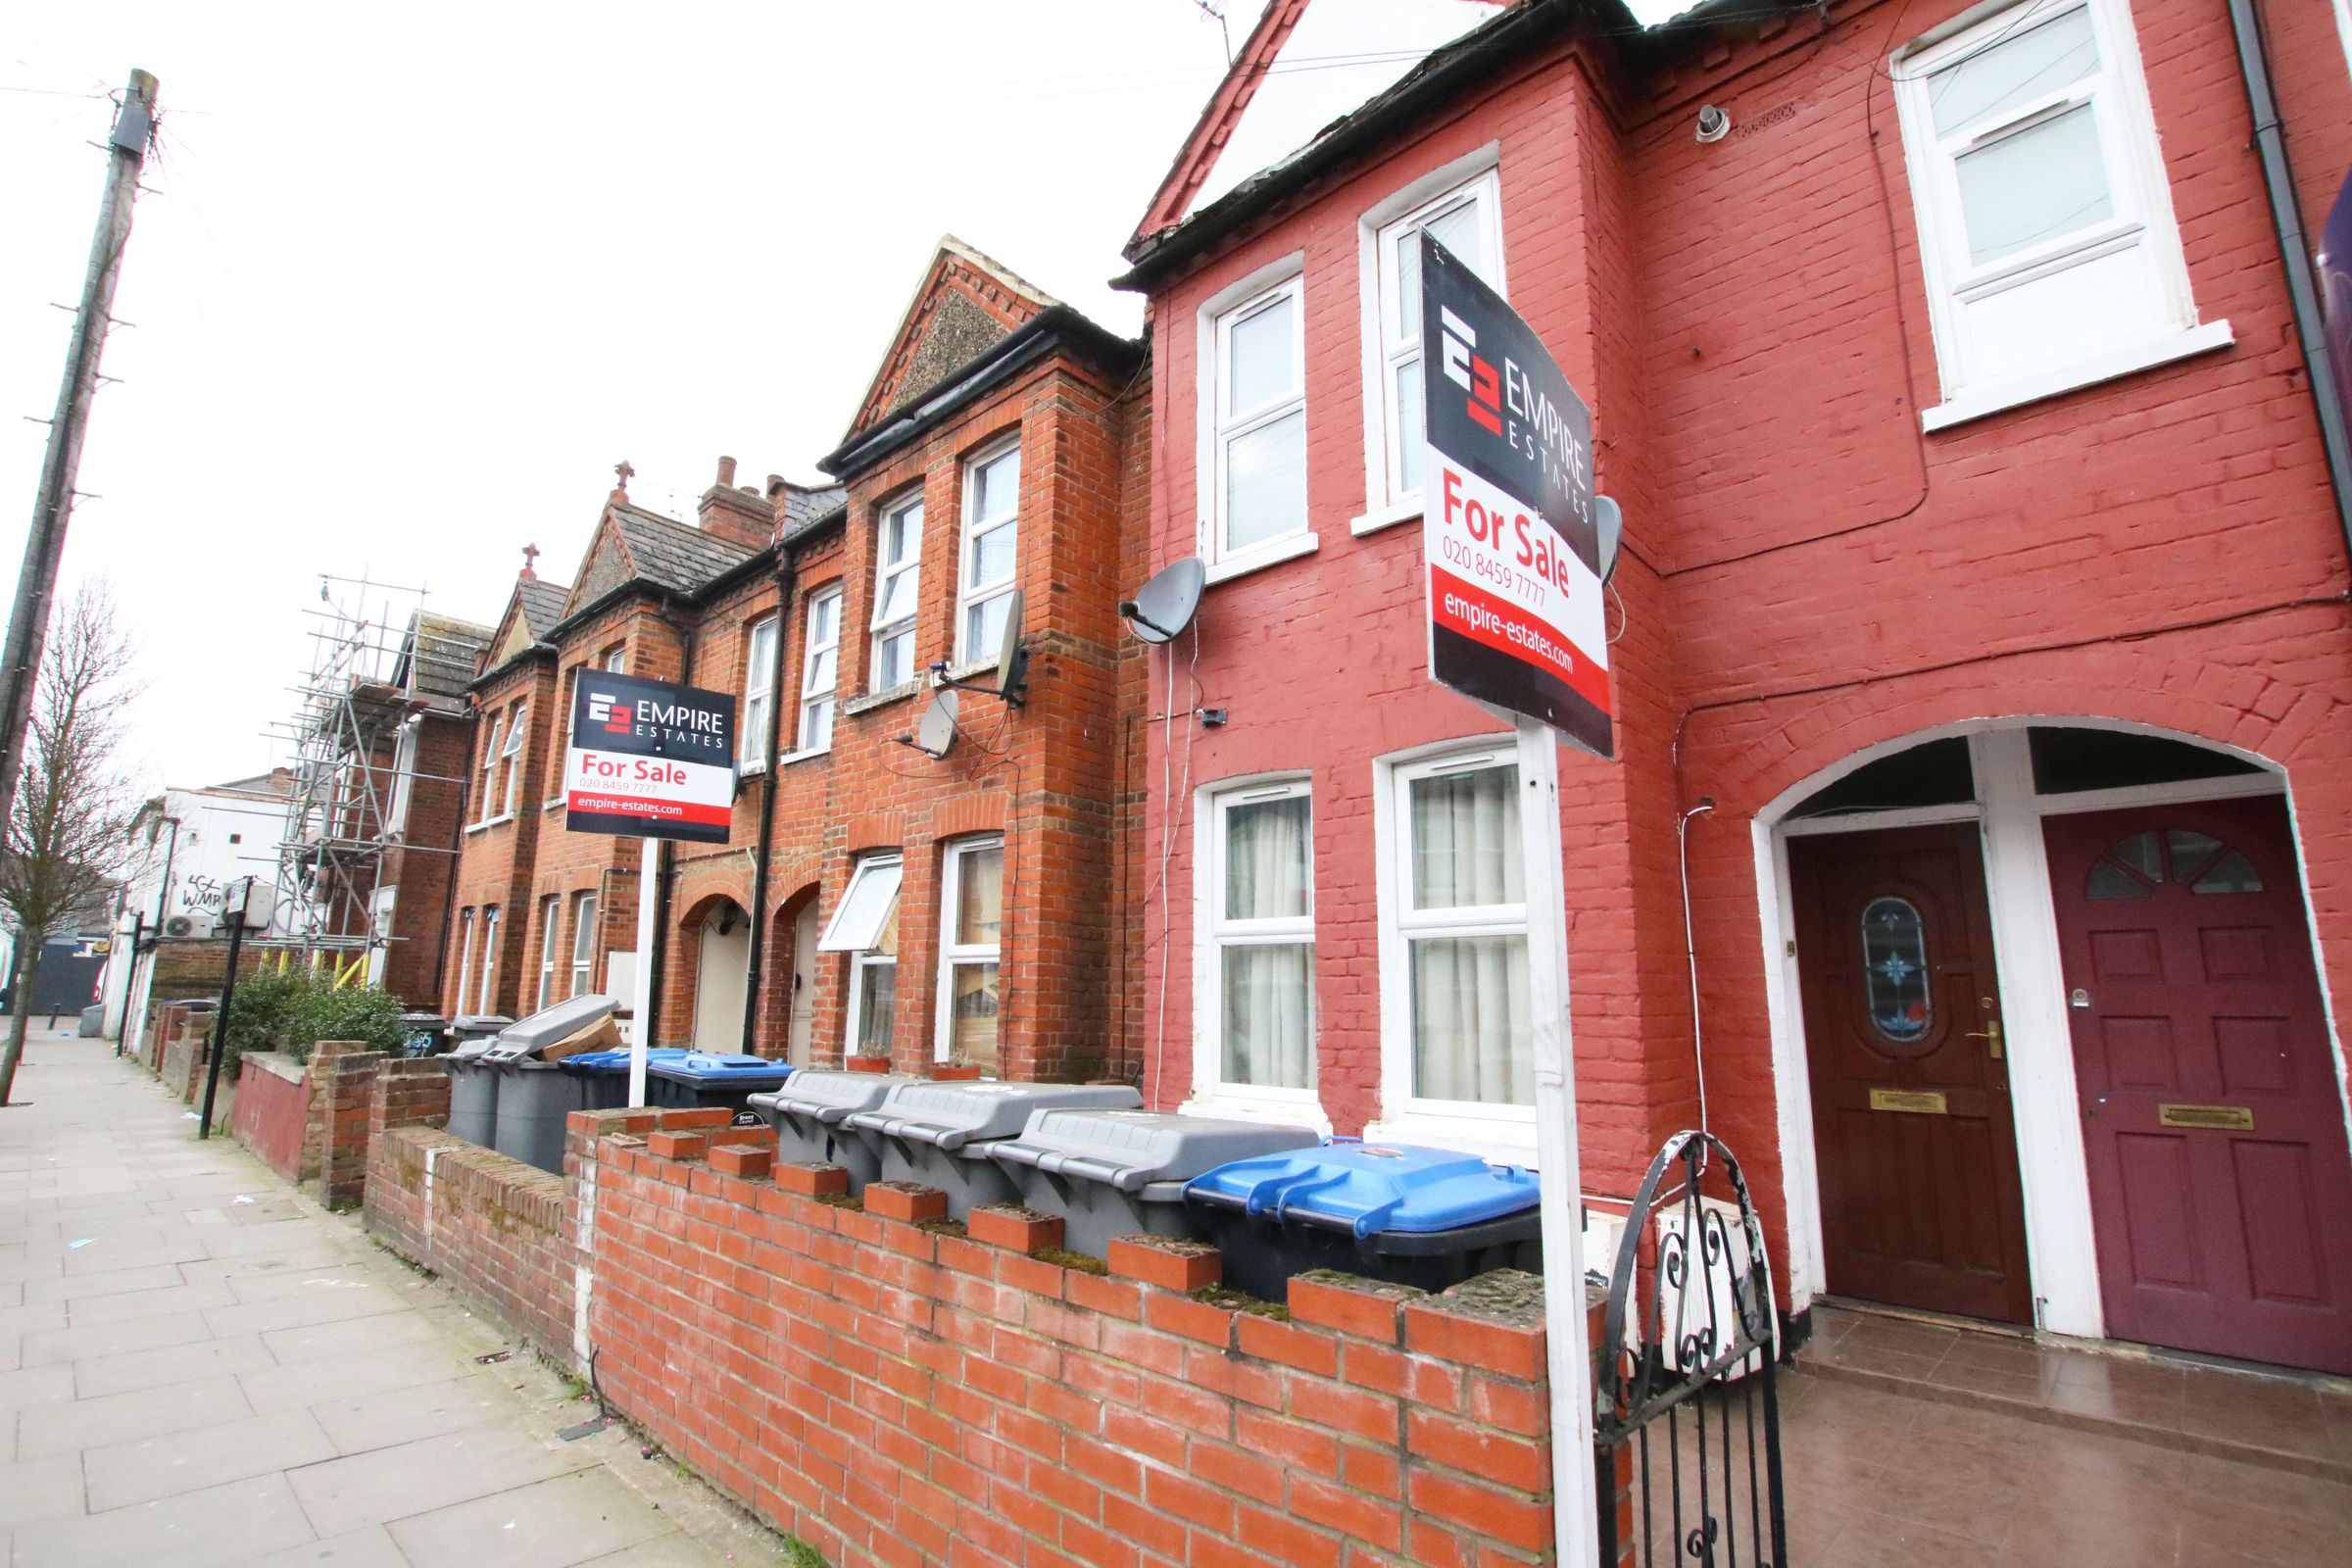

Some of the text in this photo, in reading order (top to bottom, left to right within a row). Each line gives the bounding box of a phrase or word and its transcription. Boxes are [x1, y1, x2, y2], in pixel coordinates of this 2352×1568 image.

[1504, 356, 1586, 491] EMPIRE
[1508, 419, 1589, 524] ESTATES
[1443, 466, 1569, 599] For Sale
[1443, 535, 1545, 608] 020 8459 7777
[1445, 592, 1574, 675] empire-estates.com
[636, 724, 723, 749] ESTATES
[637, 699, 723, 735] EMPIRE
[579, 777, 658, 795] 020 8459 7777
[581, 754, 687, 785] For Sale
[577, 797, 683, 816] empire-estates.com
